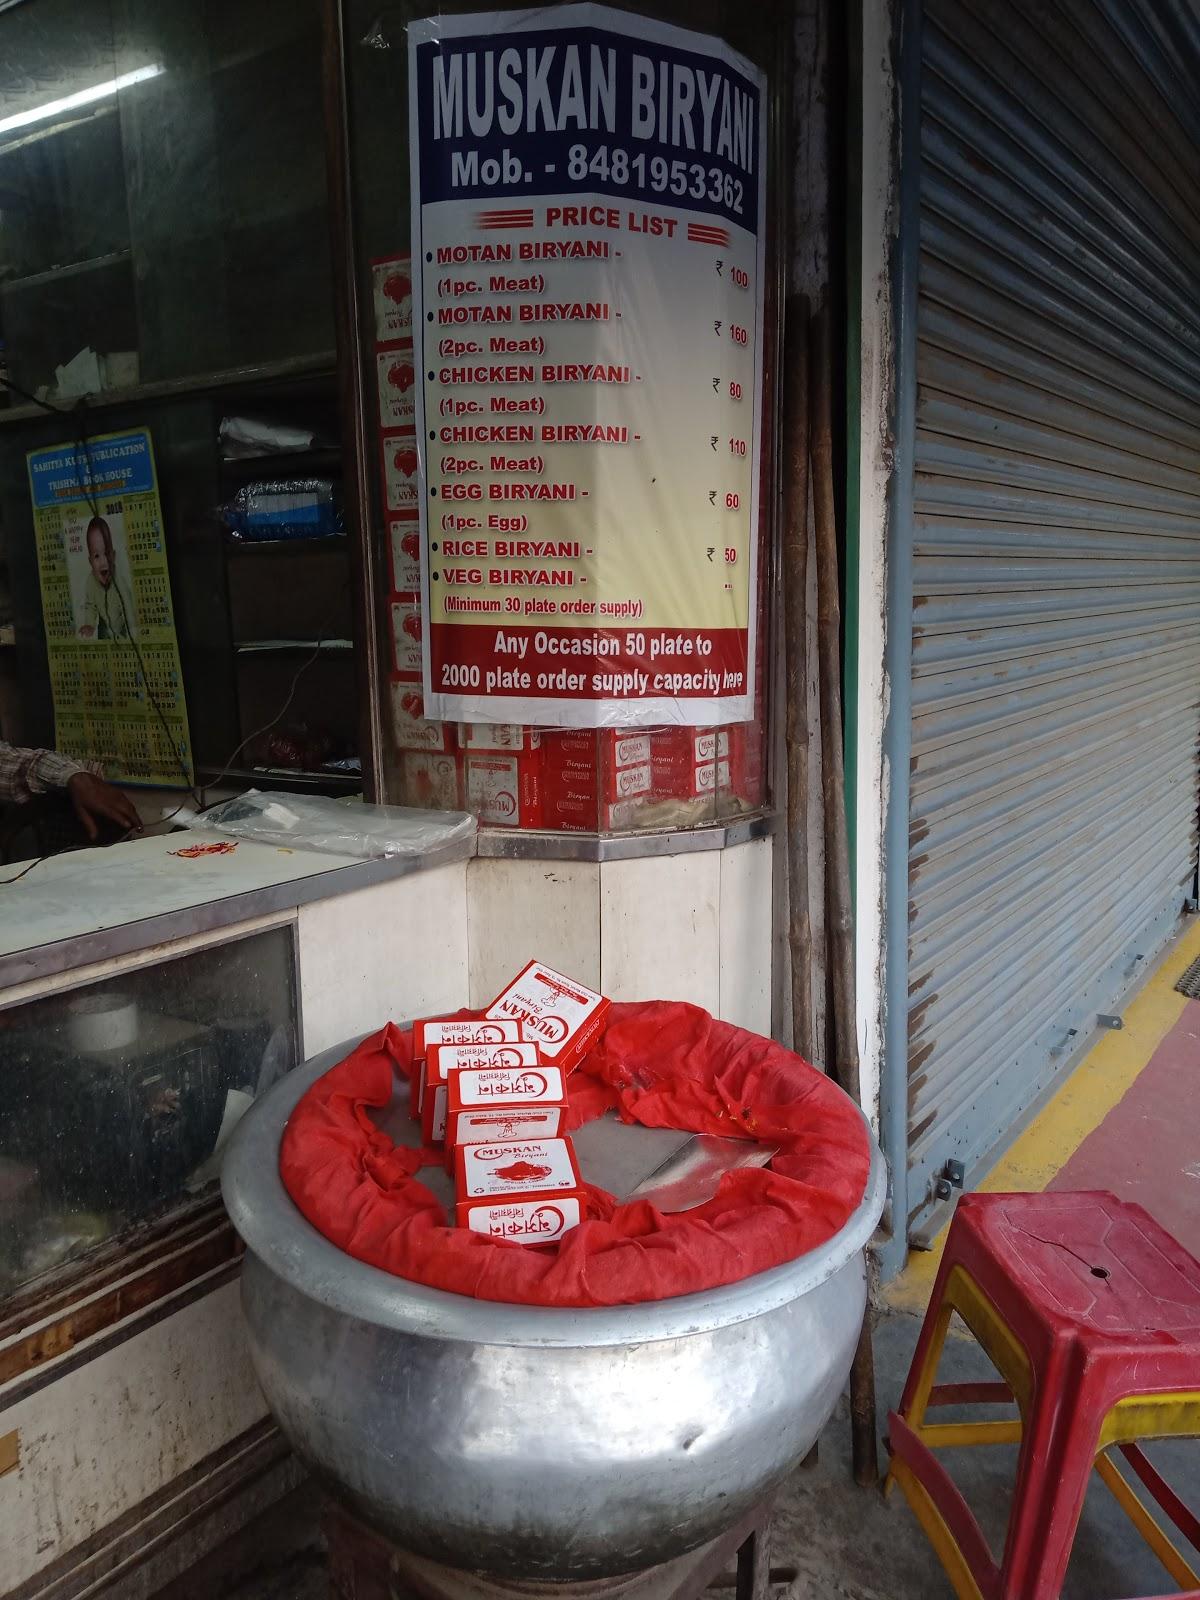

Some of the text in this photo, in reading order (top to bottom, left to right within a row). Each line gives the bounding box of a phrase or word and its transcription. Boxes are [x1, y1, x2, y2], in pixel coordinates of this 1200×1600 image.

[433, 44, 753, 175] MUSKAN BIRYANI
[451, 148, 532, 187] Mob.
[568, 143, 743, 214] 8481953362
[546, 206, 678, 238] PRICE LIST
[436, 244, 512, 264] MOTAN
[519, 240, 609, 260] BIRYANI
[730, 267, 748, 288] 100
[437, 274, 545, 297] (1pc. Meat)
[438, 305, 512, 325] MOTAN
[519, 303, 609, 322] BIRYANI
[730, 324, 747, 344] 160
[438, 336, 545, 358] (2pc. Meat)
[439, 365, 534, 384] CHICKEN
[542, 364, 629, 383] BIRYANI
[729, 382, 741, 399] 80
[439, 397, 545, 416] (1pc. Meat)
[439, 425, 534, 443] CHICKEN
[541, 425, 627, 443] BIRYANI
[729, 438, 746, 455] 110
[440, 456, 544, 475] (2pc. Meat)
[440, 484, 482, 500] EGG
[489, 484, 575, 500] BIRYANI
[726, 493, 739, 508] 60
[441, 515, 528, 531] (1pc. Egg)
[442, 541, 488, 556] RICE
[495, 541, 579, 557] BIRYANI
[725, 548, 736, 562] 50
[443, 568, 482, 584] VEG
[489, 569, 573, 585] BIRYANI
[443, 596, 643, 618] (Minimum 30 plate order supply)
[494, 631, 712, 660] Any Occasion 50 plate to
[441, 663, 743, 696] 2000 plate order supply capacity here
[499, 1000, 559, 1040] MUSKAN
[482, 1145, 542, 1156] MUSKAN
